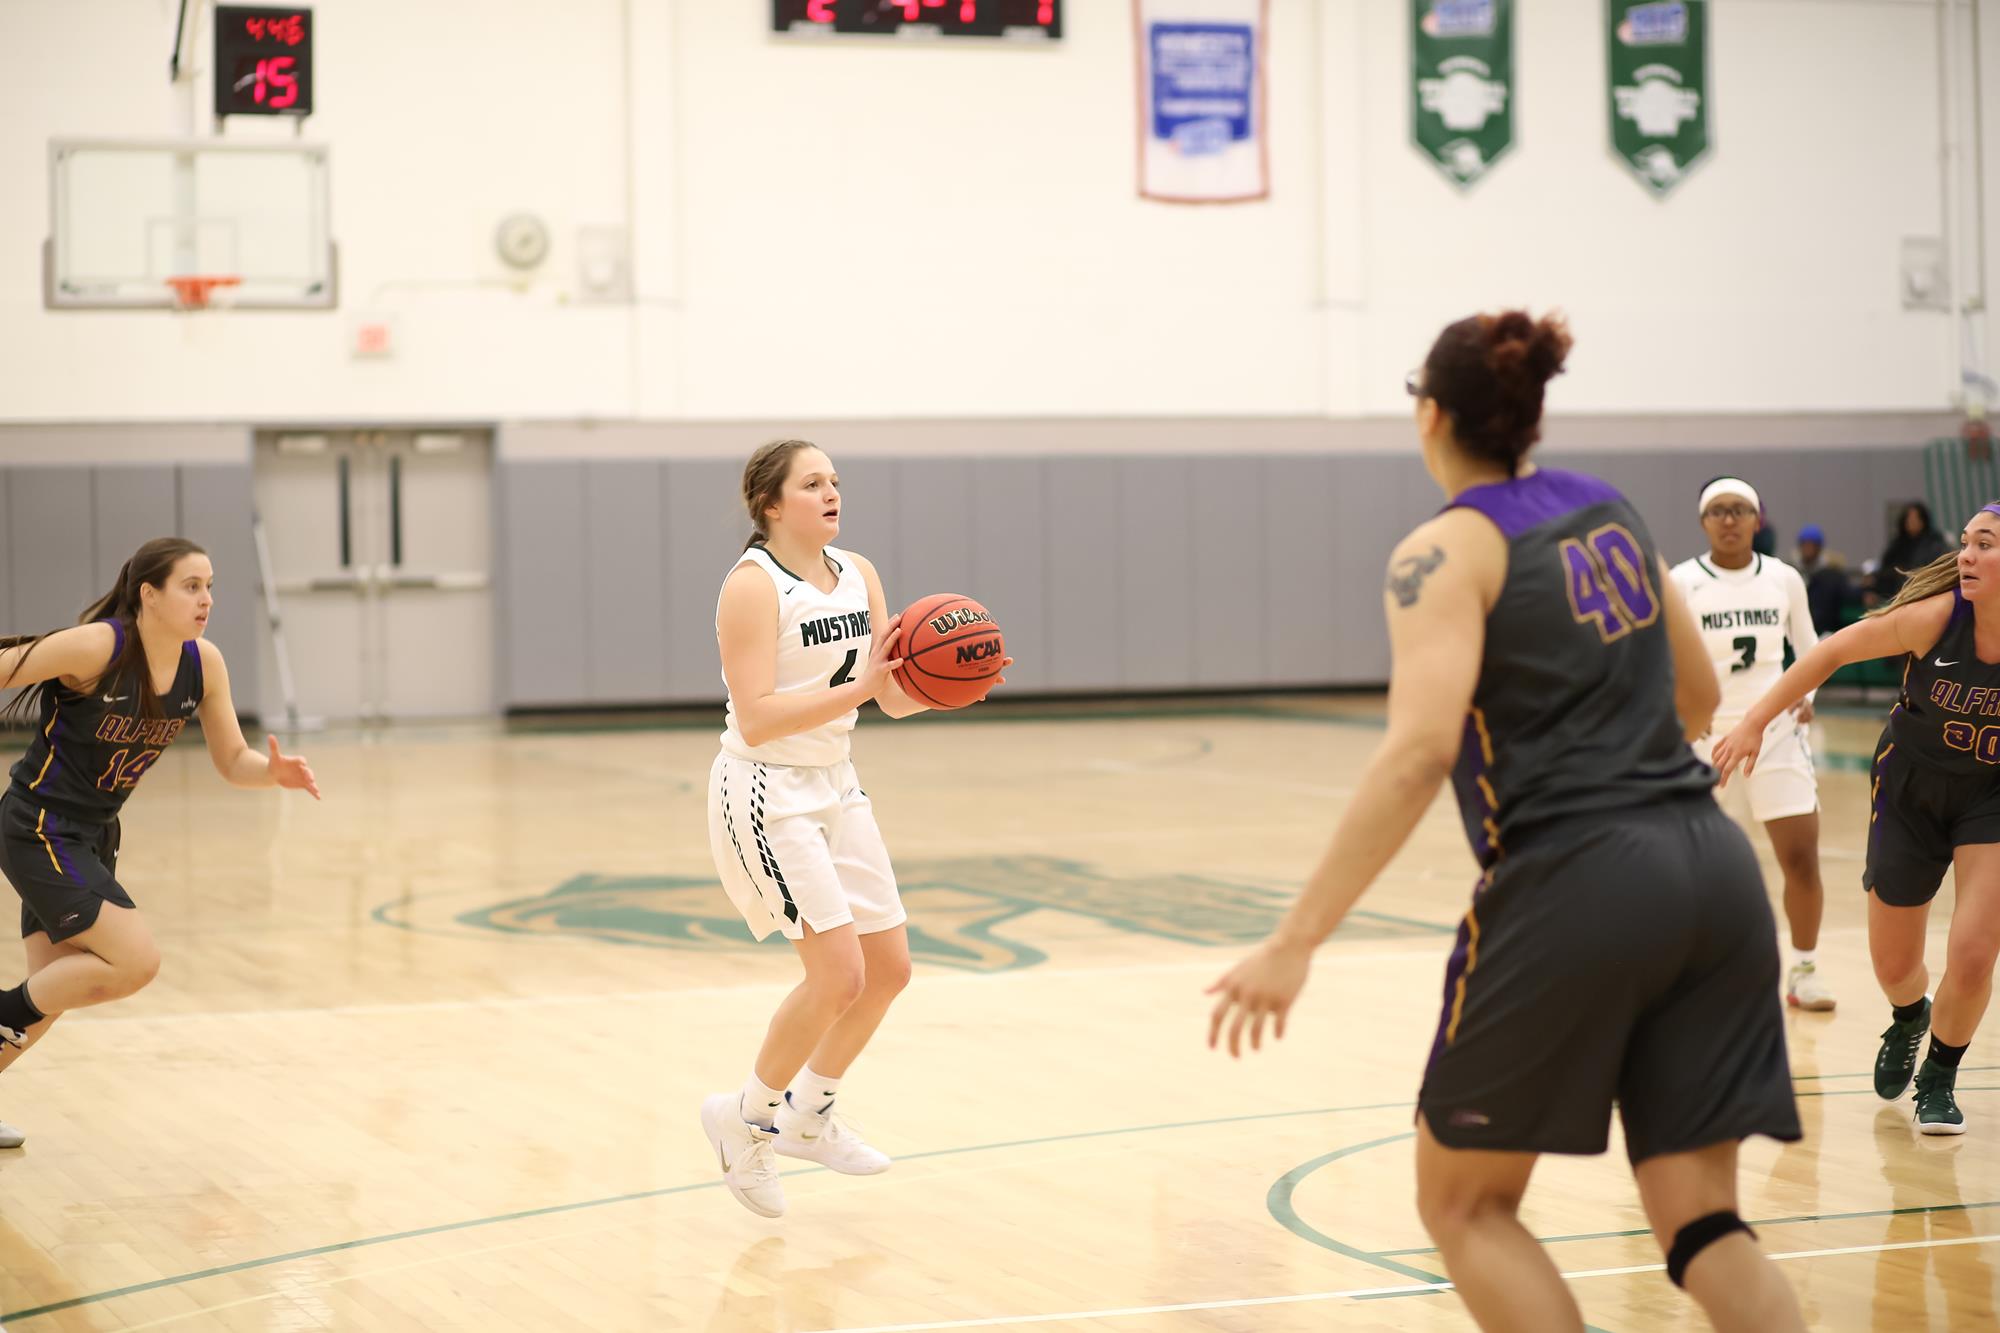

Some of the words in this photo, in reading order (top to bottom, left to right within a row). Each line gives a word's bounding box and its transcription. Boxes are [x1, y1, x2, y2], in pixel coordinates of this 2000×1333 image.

[253, 56, 299, 108] 15
[1559, 522, 1660, 646] 40
[928, 608, 997, 635] Wilso
[1702, 608, 1779, 630] MUSTANGS
[956, 638, 1001, 664] NCAA
[1731, 636, 1757, 674] 3
[1943, 720, 2000, 765] 30
[96, 748, 160, 792] 14
